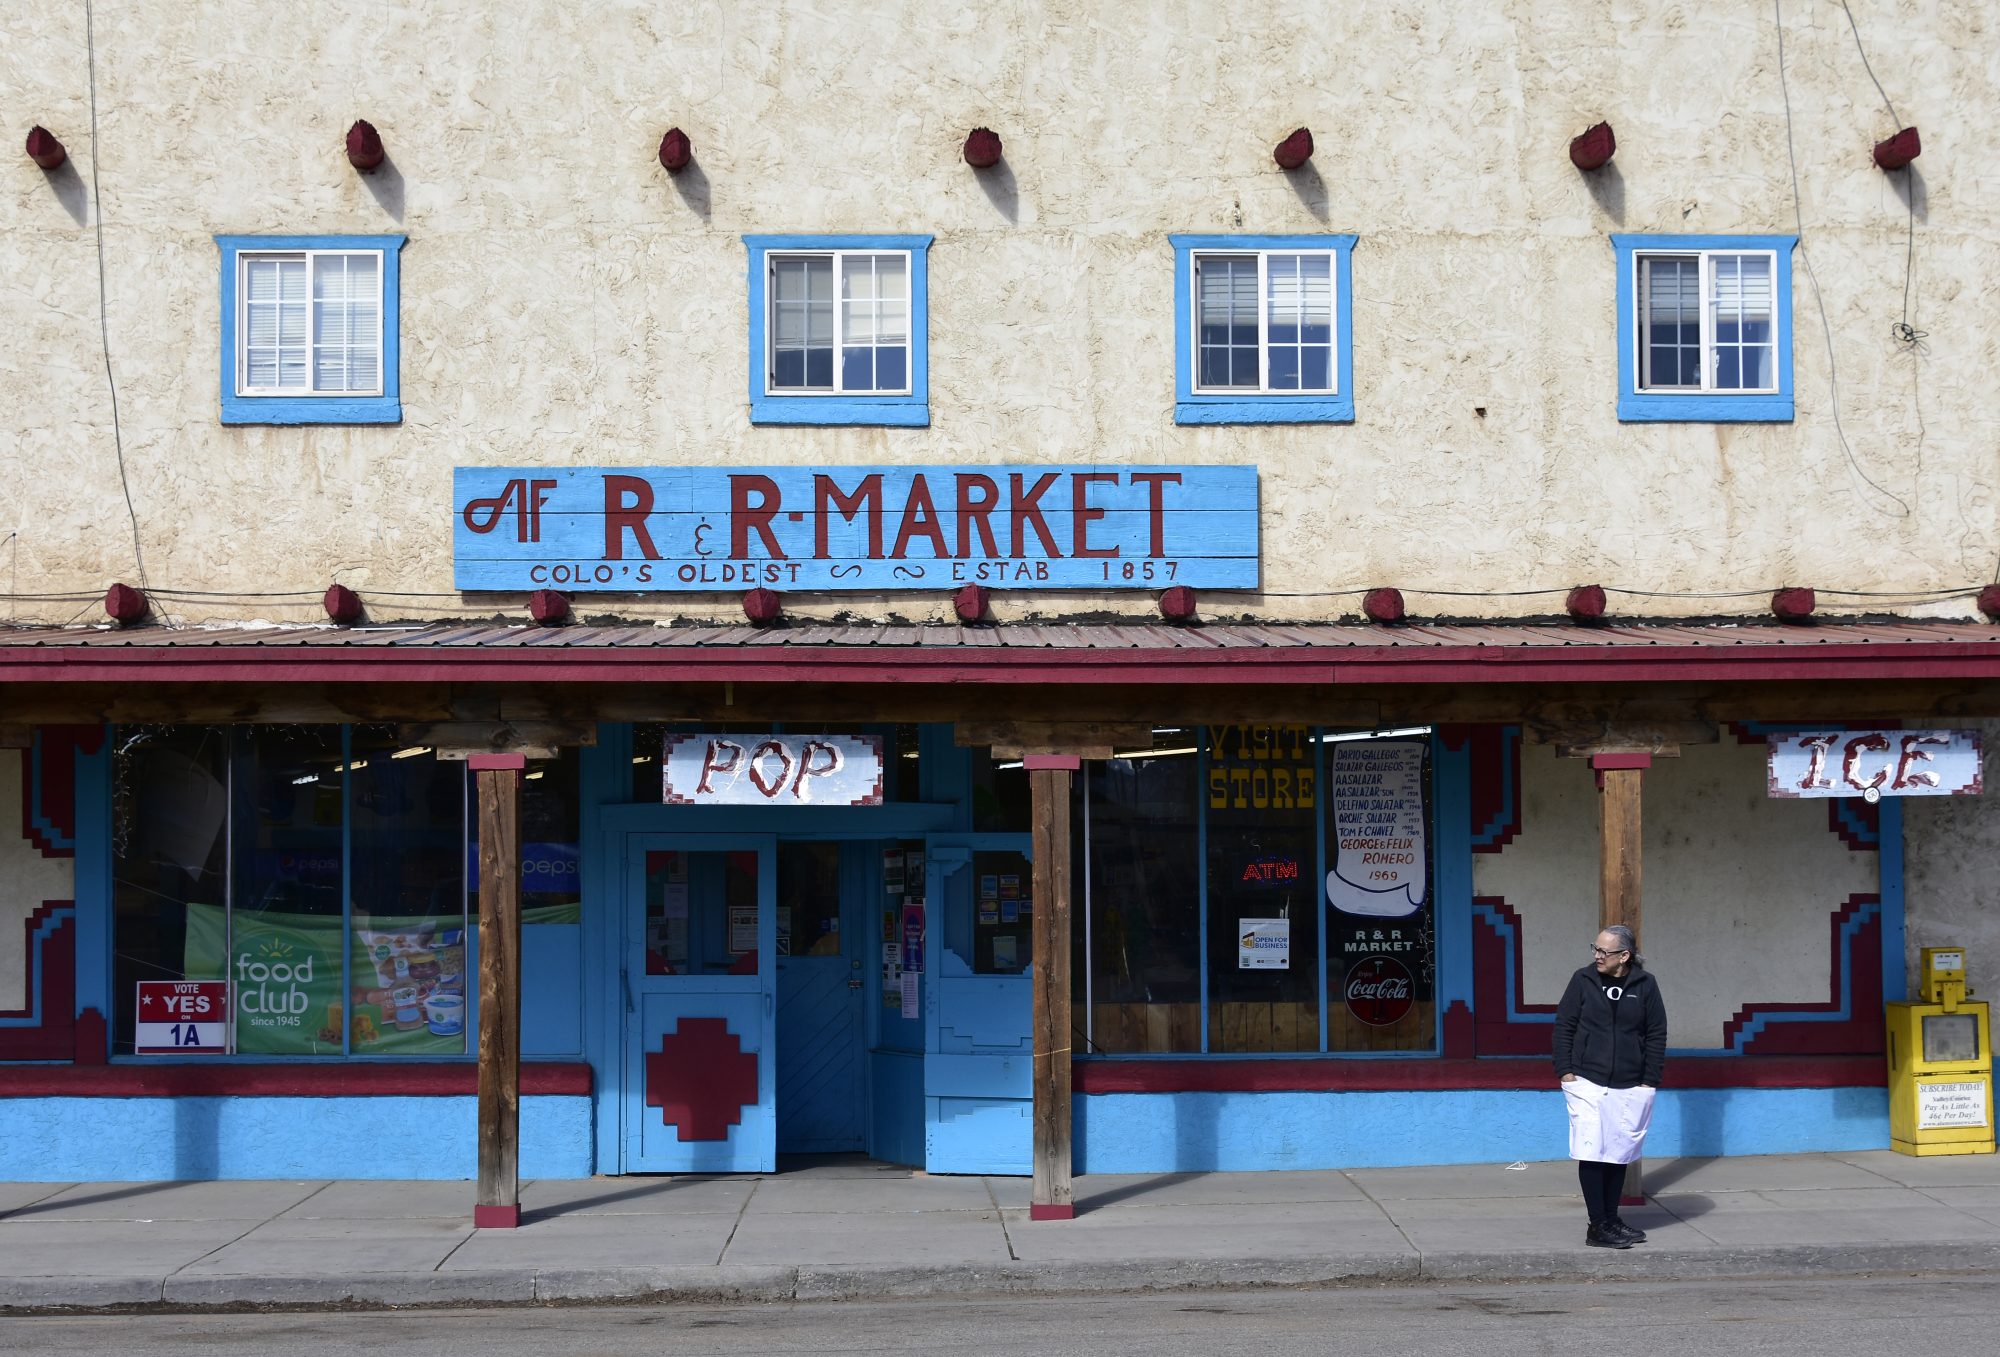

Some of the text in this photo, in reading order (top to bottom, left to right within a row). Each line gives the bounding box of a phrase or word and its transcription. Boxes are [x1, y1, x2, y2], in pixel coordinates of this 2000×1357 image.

[601, 474, 663, 560] R
[694, 516, 713, 560] &
[530, 562, 1178, 584] COLO'S OLDEST ESTAB 1857
[1209, 724, 1308, 760] VISIT
[1337, 750, 1360, 760] DARIO
[1361, 749, 1400, 760] GALLEGOS
[1335, 762, 1363, 772] SALAZAR
[1364, 762, 1404, 772] GALLEGOS
[1797, 733, 1950, 790] ICE
[696, 739, 845, 801] POP
[1209, 767, 1315, 809] STORE
[1337, 799, 1405, 811] DELFINO SALAZAR
[1338, 812, 1397, 824] ARCHIE SALAZAR
[1338, 827, 1356, 837] TOM
[1364, 825, 1395, 837] CHAVEZ
[1361, 852, 1415, 865] ROMERO
[521, 858, 580, 877] pepsi
[1241, 861, 1299, 881] ATM
[1369, 870, 1398, 881] 1969
[1355, 930, 1402, 940] R & R
[1344, 941, 1413, 952] MARKET
[236, 952, 313, 983] food
[174, 983, 200, 994] VOTE
[162, 995, 211, 1013] YES
[240, 982, 309, 1014] club
[251, 1016, 301, 1026] since 1945
[170, 1023, 200, 1046] 1A
[1919, 1084, 1957, 1093] SUBSCRIBE
[1924, 1104, 1938, 1112] Pay
[1950, 1102, 1970, 1110] Little
